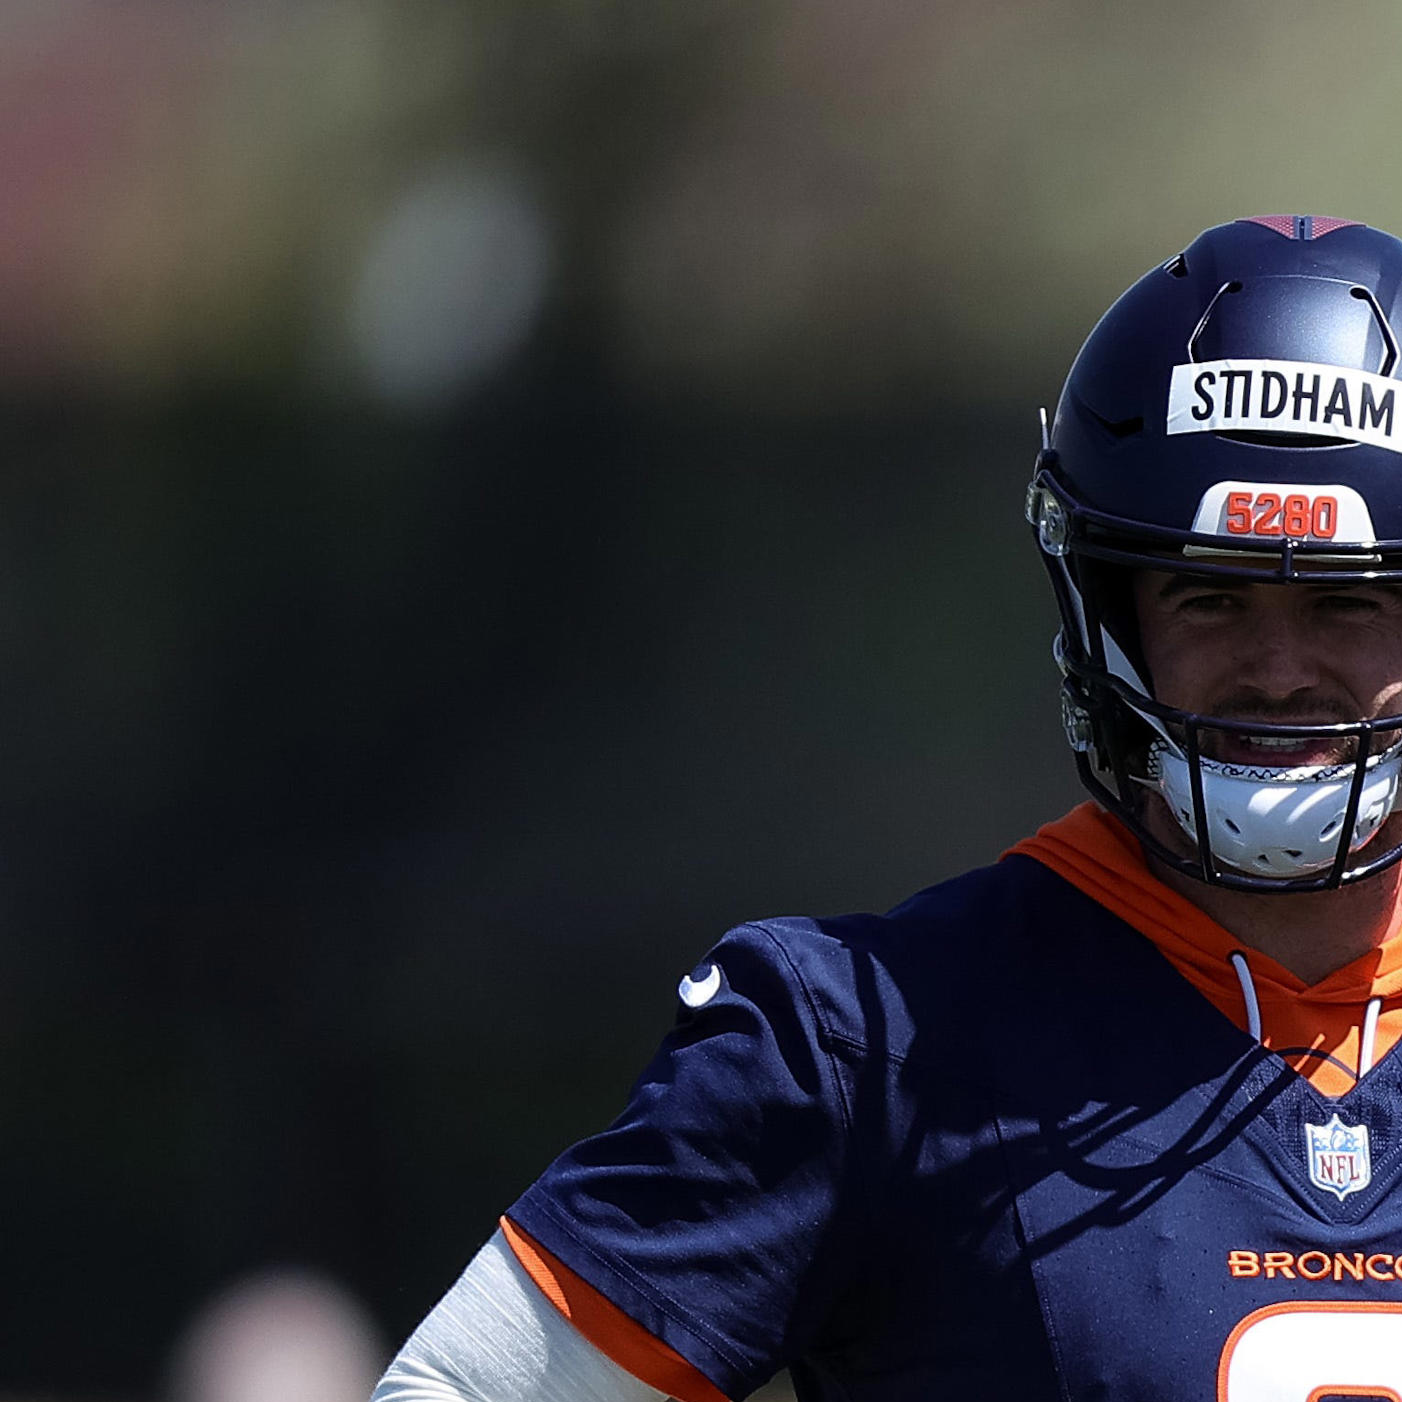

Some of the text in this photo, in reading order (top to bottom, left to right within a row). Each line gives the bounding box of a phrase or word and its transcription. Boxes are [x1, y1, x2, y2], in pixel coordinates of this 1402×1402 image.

[1190, 370, 1396, 438] STIDHAM
[1226, 492, 1338, 539] 5280
[1319, 1153, 1361, 1183] NFL
